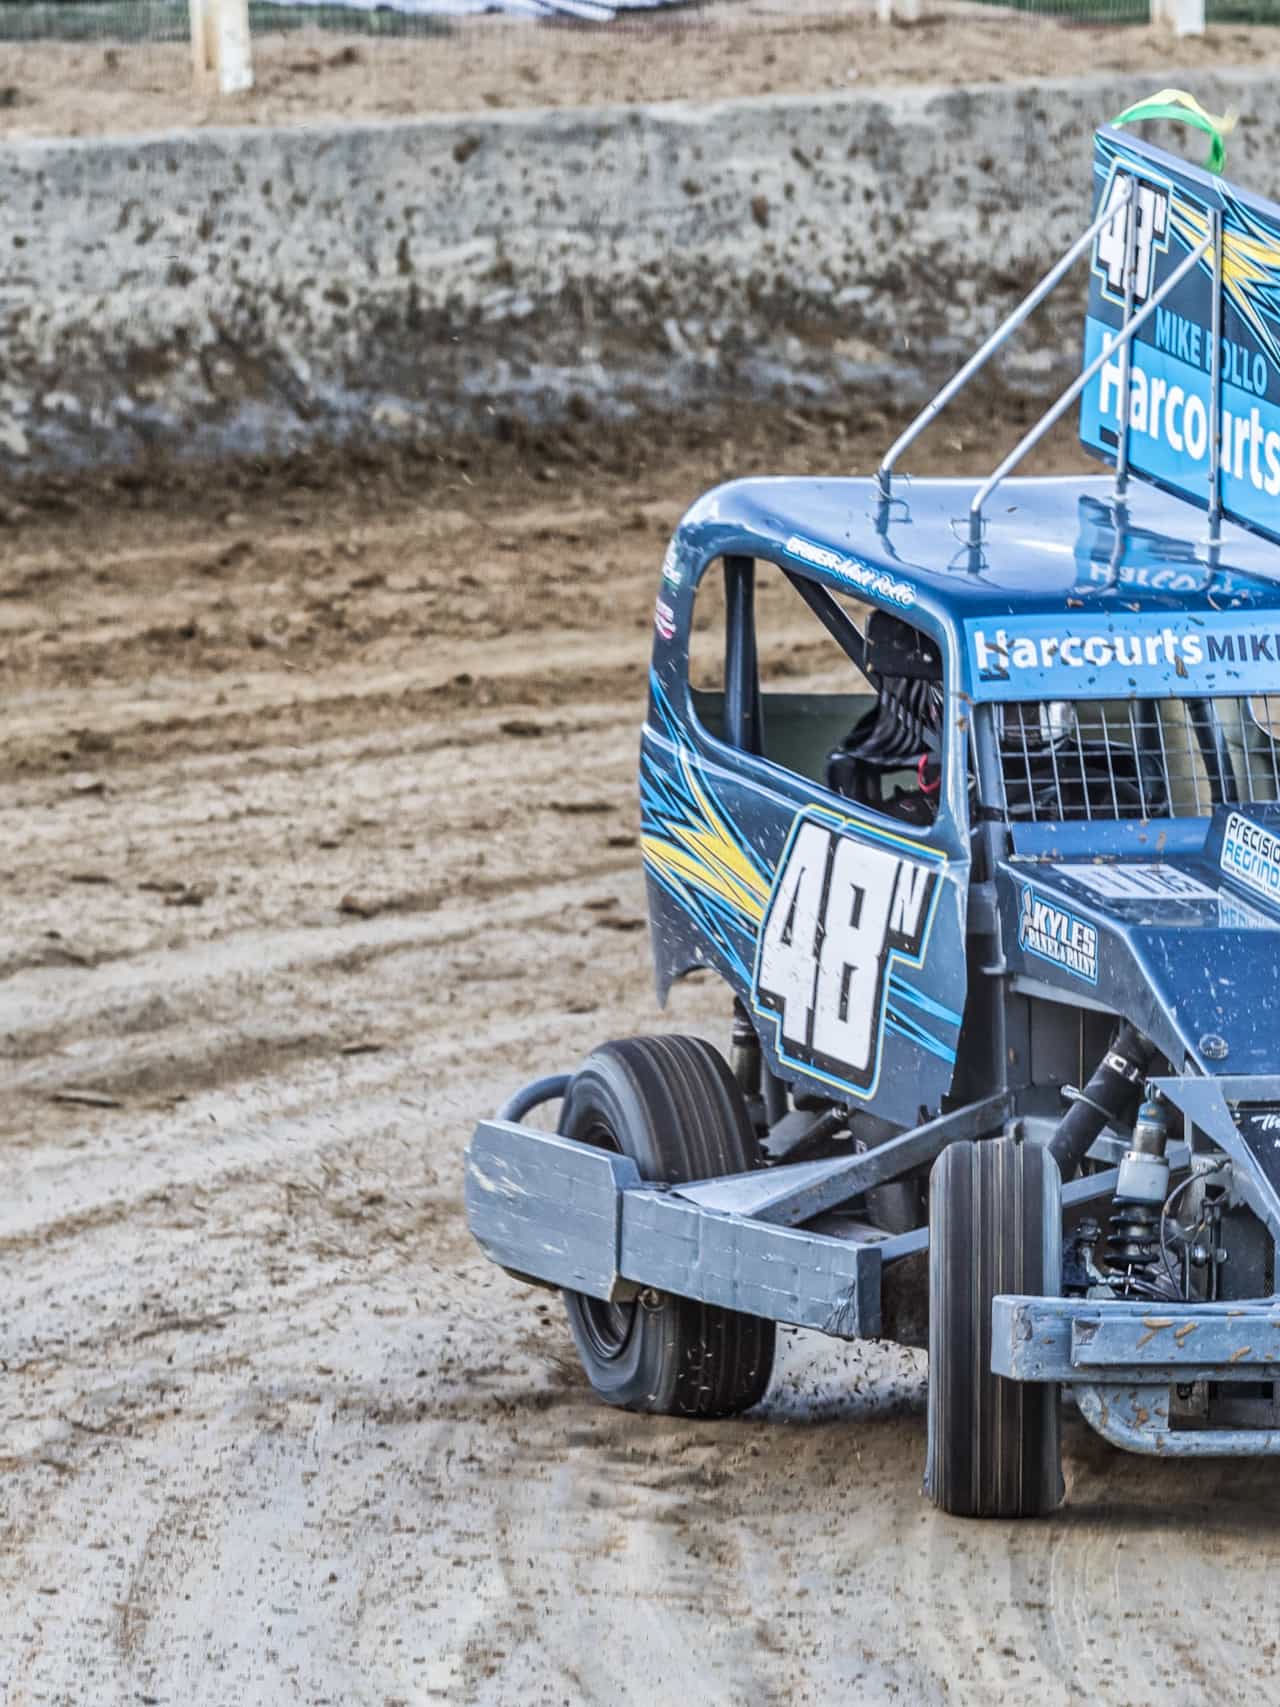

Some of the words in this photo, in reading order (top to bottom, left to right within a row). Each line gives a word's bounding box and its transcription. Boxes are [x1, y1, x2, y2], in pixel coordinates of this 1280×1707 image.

[1155, 305, 1201, 372] MIKE
[973, 629, 1203, 669] Harcourts
[1032, 902, 1096, 958] KYLES
[1066, 946, 1096, 978] PAINT
